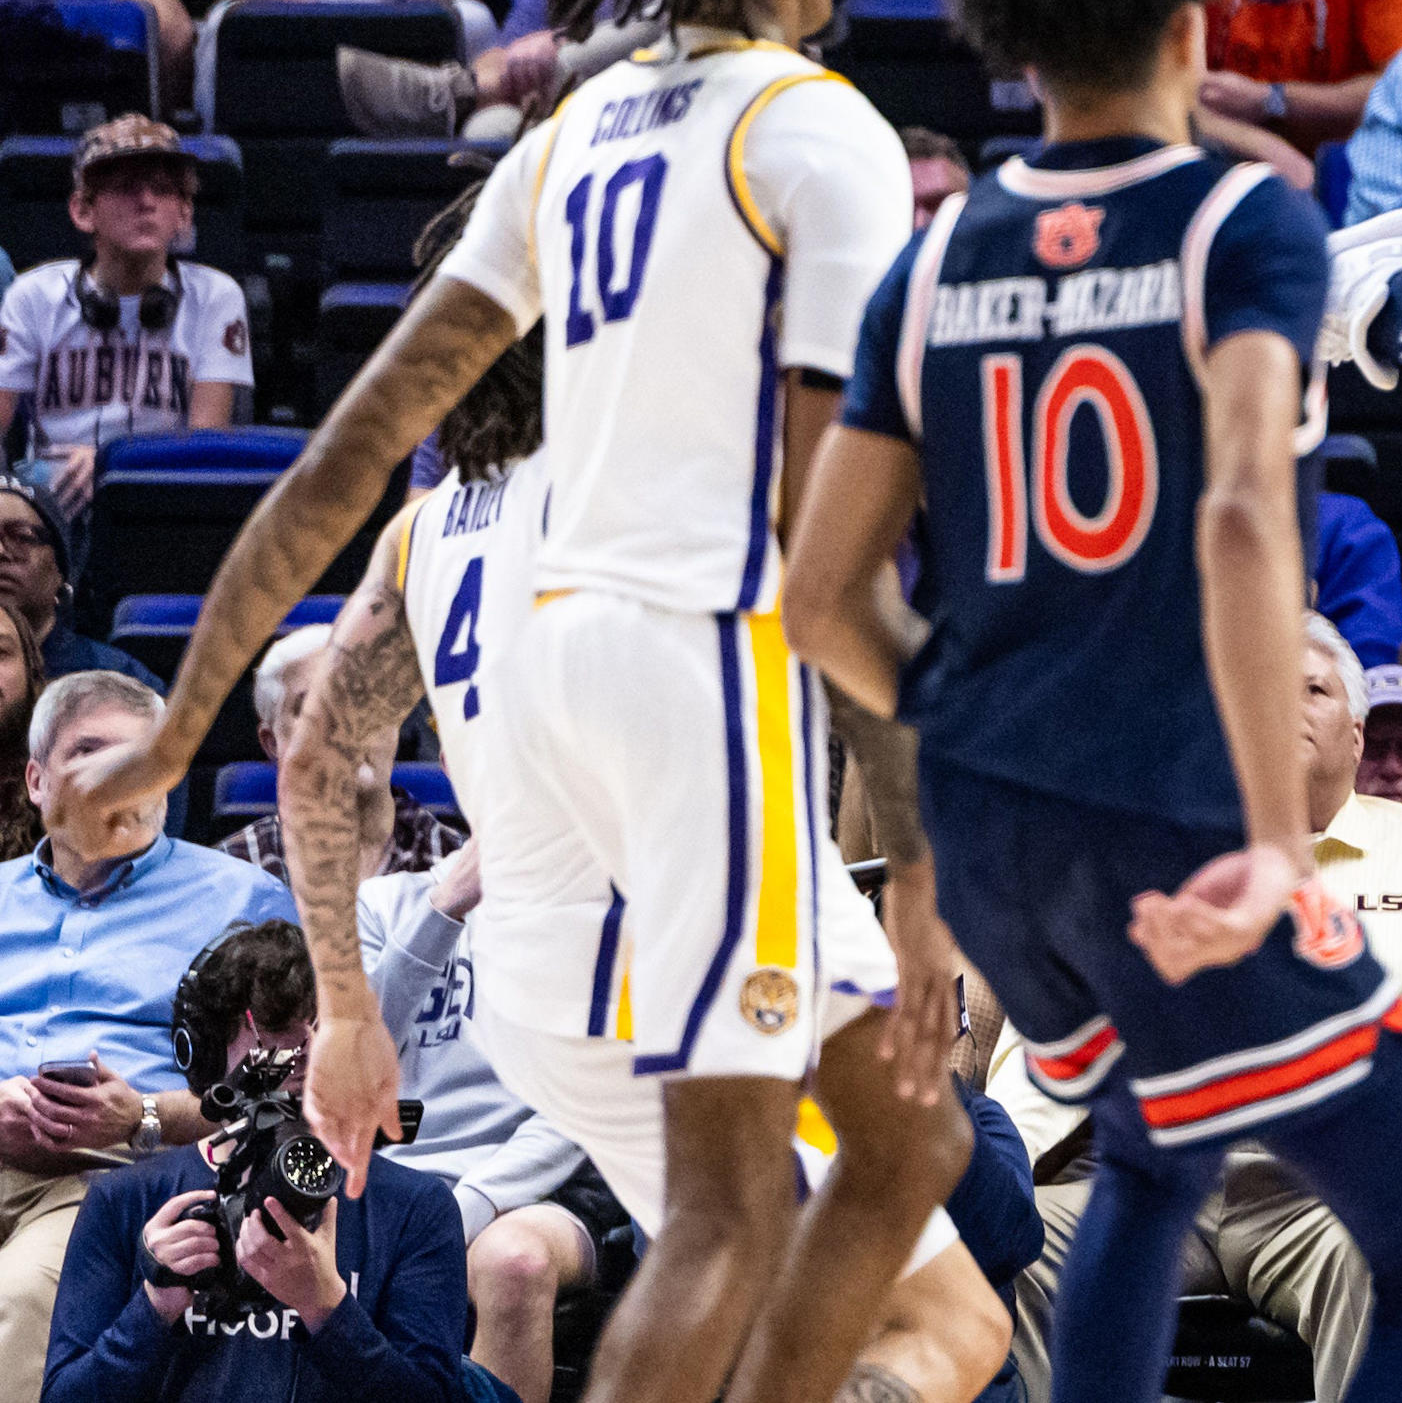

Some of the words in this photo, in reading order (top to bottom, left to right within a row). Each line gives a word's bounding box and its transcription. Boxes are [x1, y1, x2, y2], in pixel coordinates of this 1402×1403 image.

[566, 150, 668, 348] 10
[44, 348, 191, 413] AUBURN
[980, 344, 1160, 584] 10
[435, 556, 484, 722] 4
